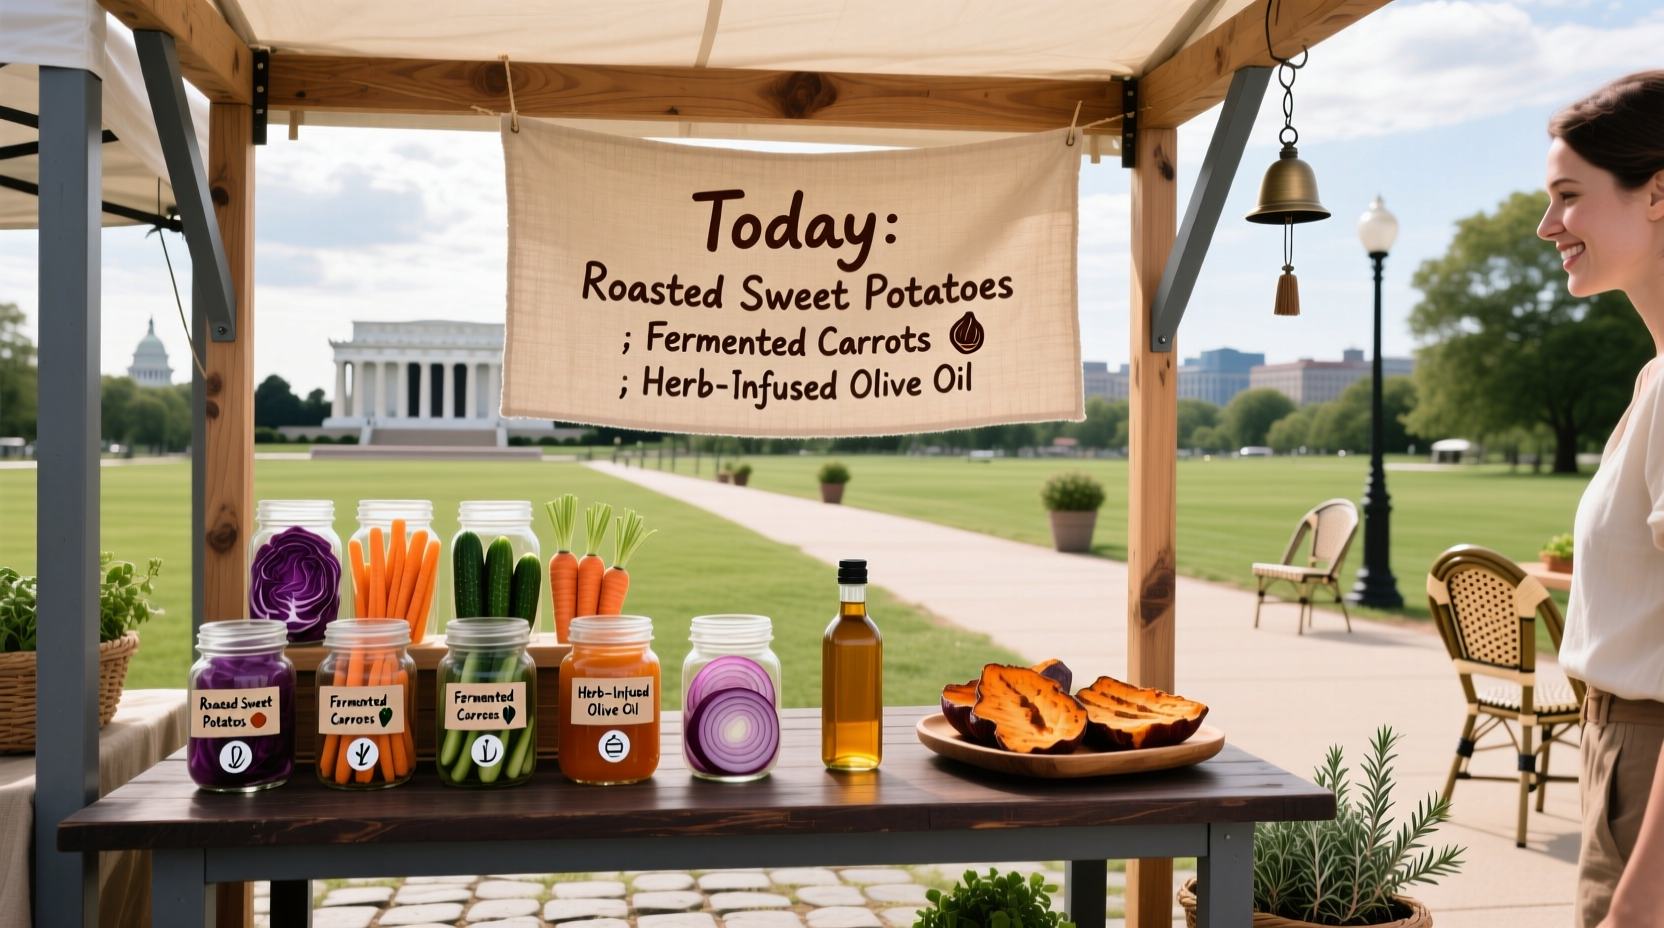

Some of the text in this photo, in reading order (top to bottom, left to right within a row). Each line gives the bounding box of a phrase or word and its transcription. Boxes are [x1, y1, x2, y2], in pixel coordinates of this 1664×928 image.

[692, 188, 898, 273] Today:
[582, 260, 1014, 312] Roasted Sweet Potatoes
[646, 320, 807, 357] Fermented
[818, 325, 931, 357] Carrots
[642, 365, 838, 411] Herb-Infused
[849, 368, 922, 399] Olive
[933, 361, 973, 395] Oil
[587, 702, 639, 717] Olive Oil
